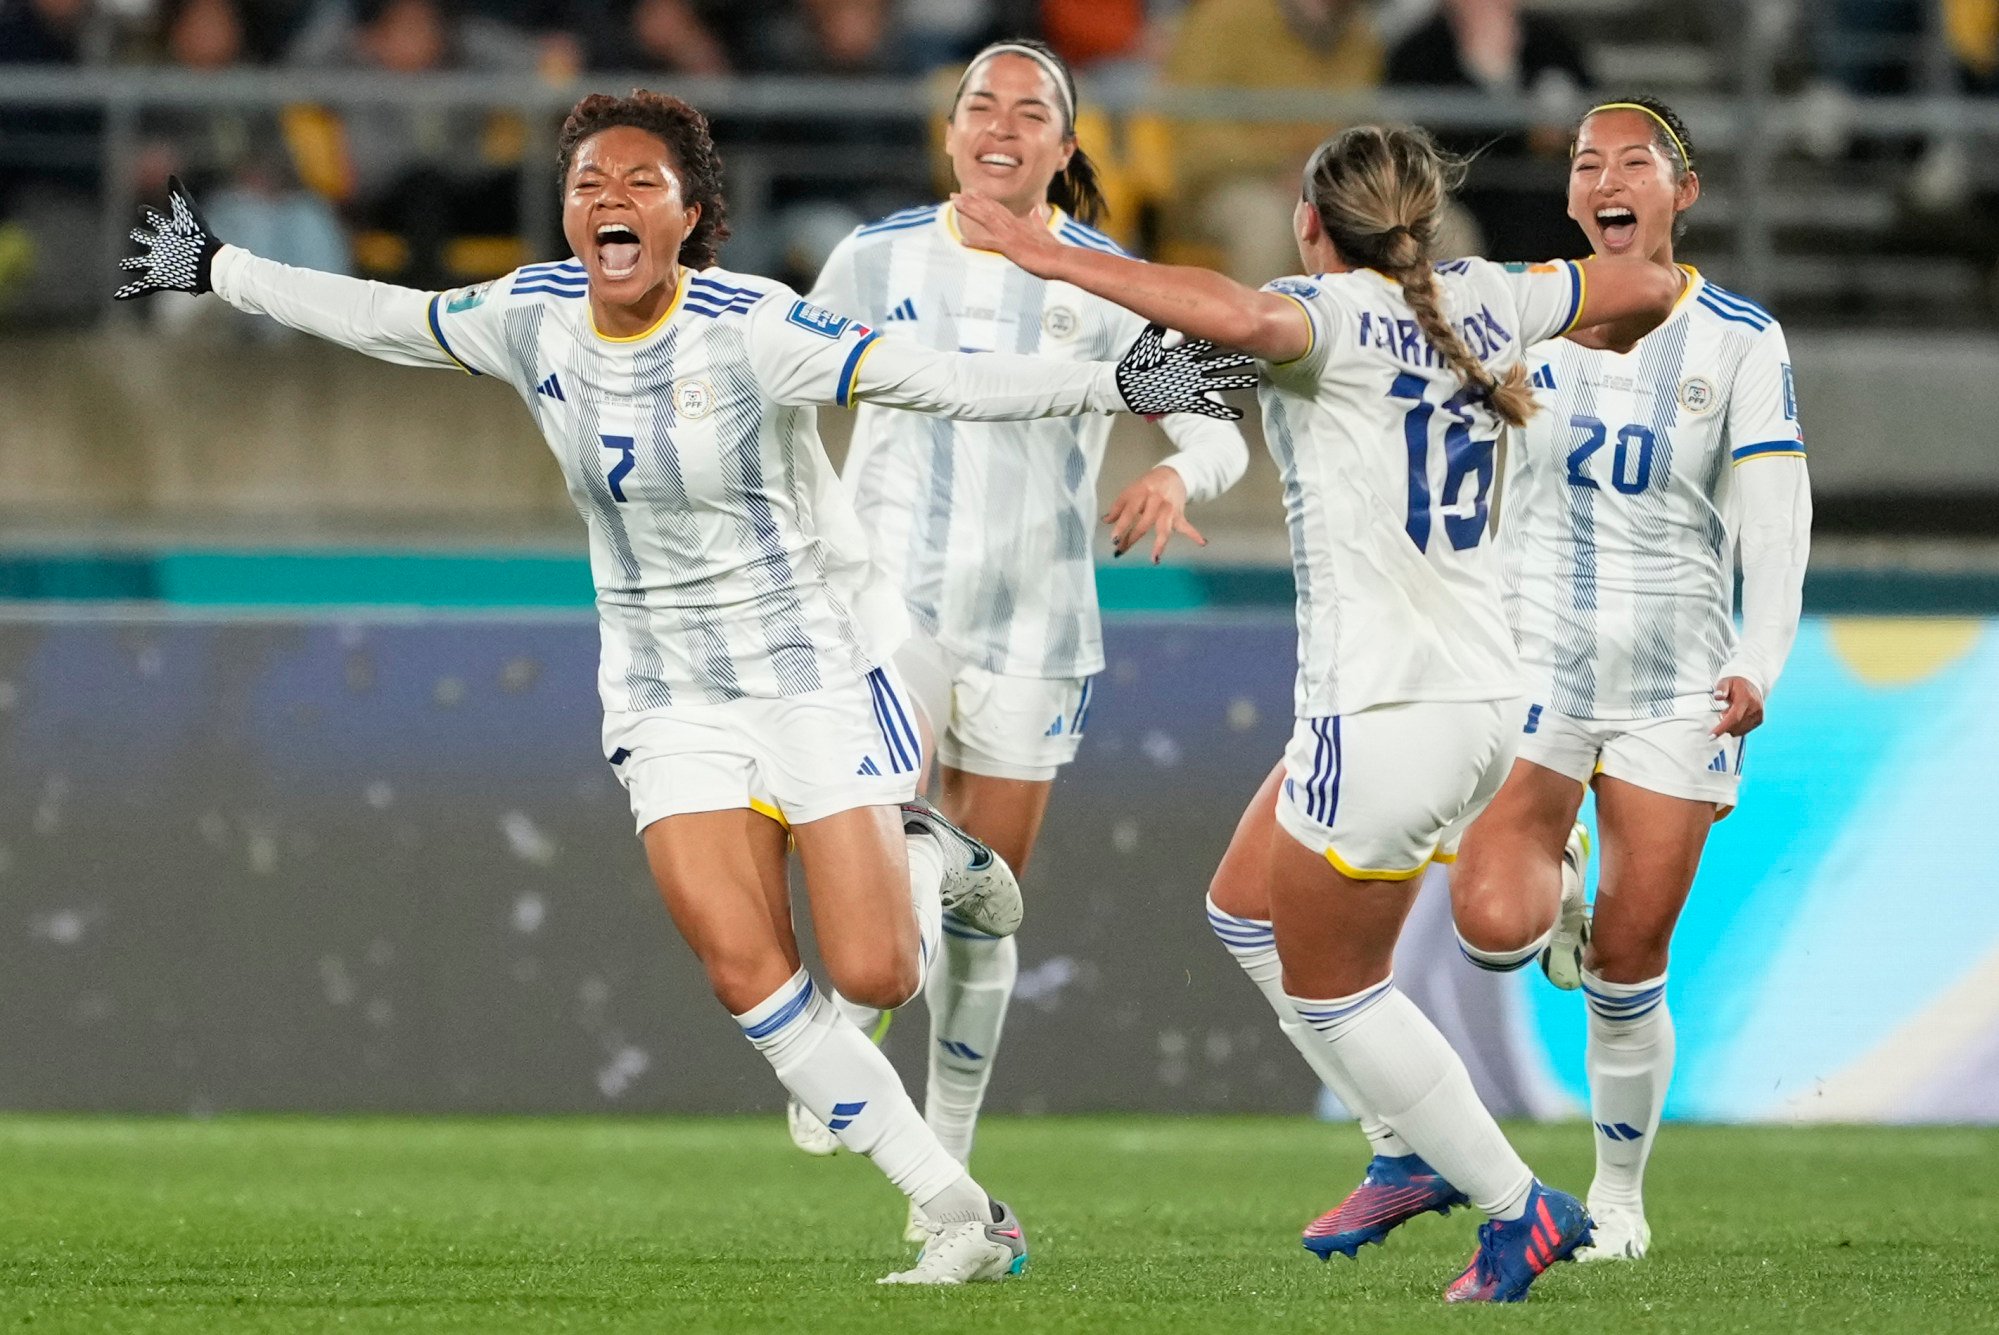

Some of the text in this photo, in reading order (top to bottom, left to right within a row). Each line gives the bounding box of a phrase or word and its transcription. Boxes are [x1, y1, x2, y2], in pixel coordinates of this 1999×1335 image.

[1357, 303, 1513, 369] ARON
[599, 434, 636, 503] 7
[1384, 371, 1498, 555] 16
[1566, 414, 1655, 495] 20
